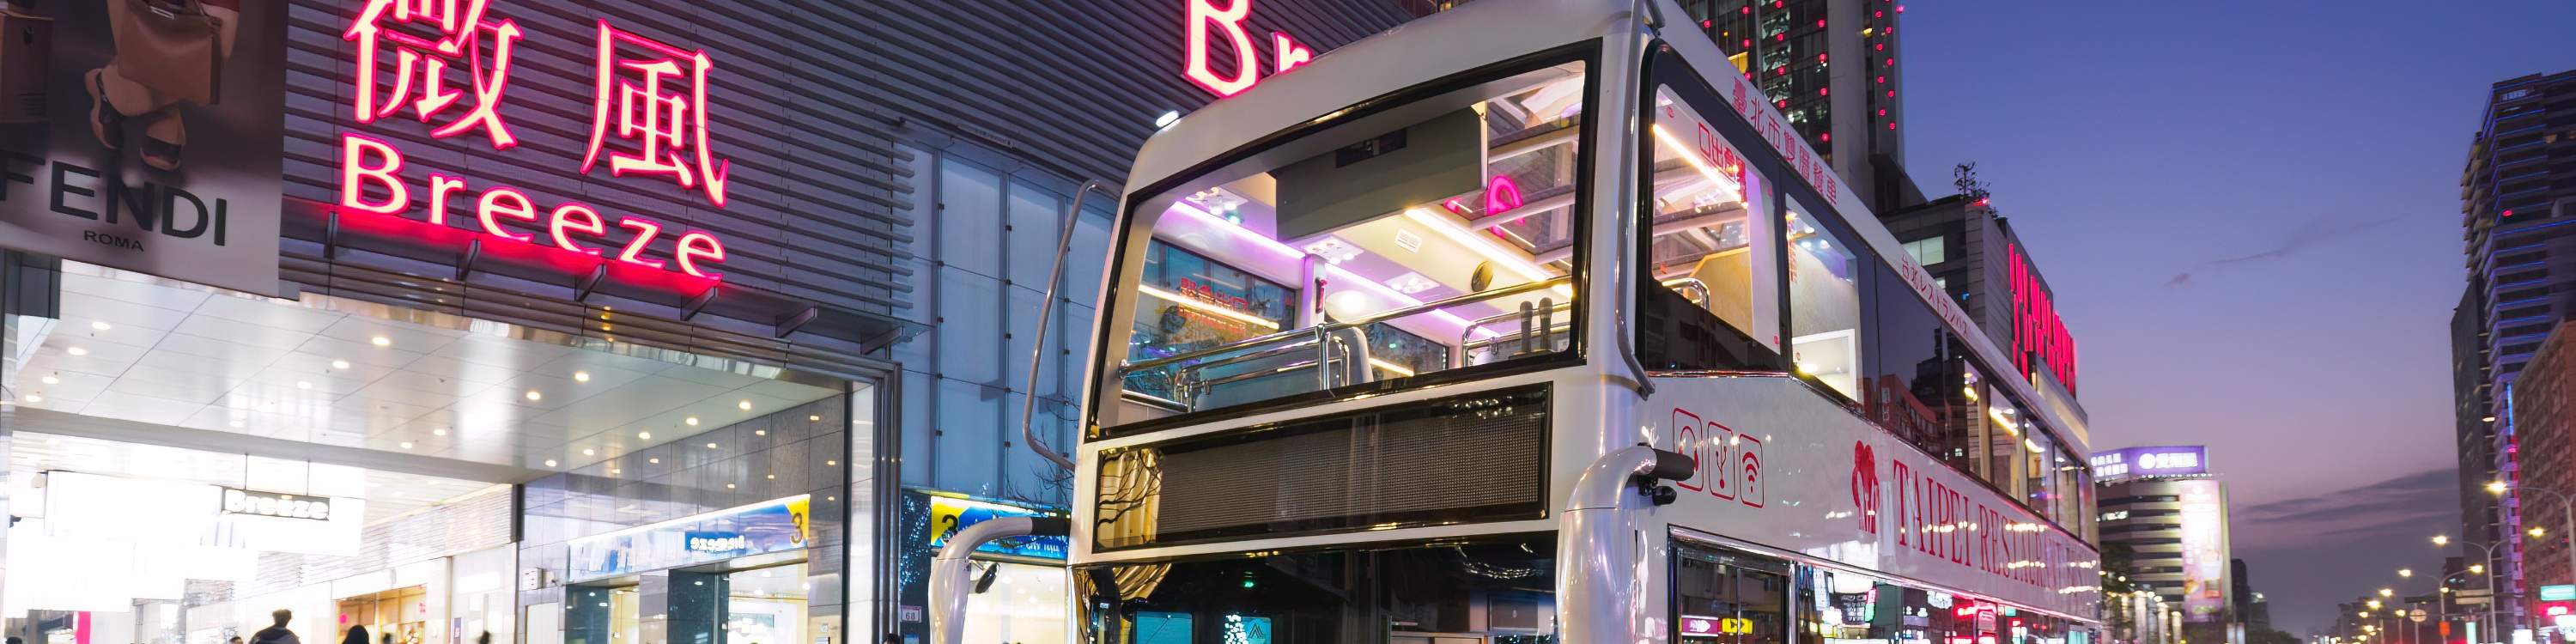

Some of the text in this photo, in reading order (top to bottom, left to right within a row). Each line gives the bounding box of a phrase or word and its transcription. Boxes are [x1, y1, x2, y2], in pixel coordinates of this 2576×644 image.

[0, 149, 227, 246] FENDI
[83, 229, 144, 252] ROMA
[342, 132, 727, 281] Breeze
[1893, 459, 1971, 567] TAIPEI
